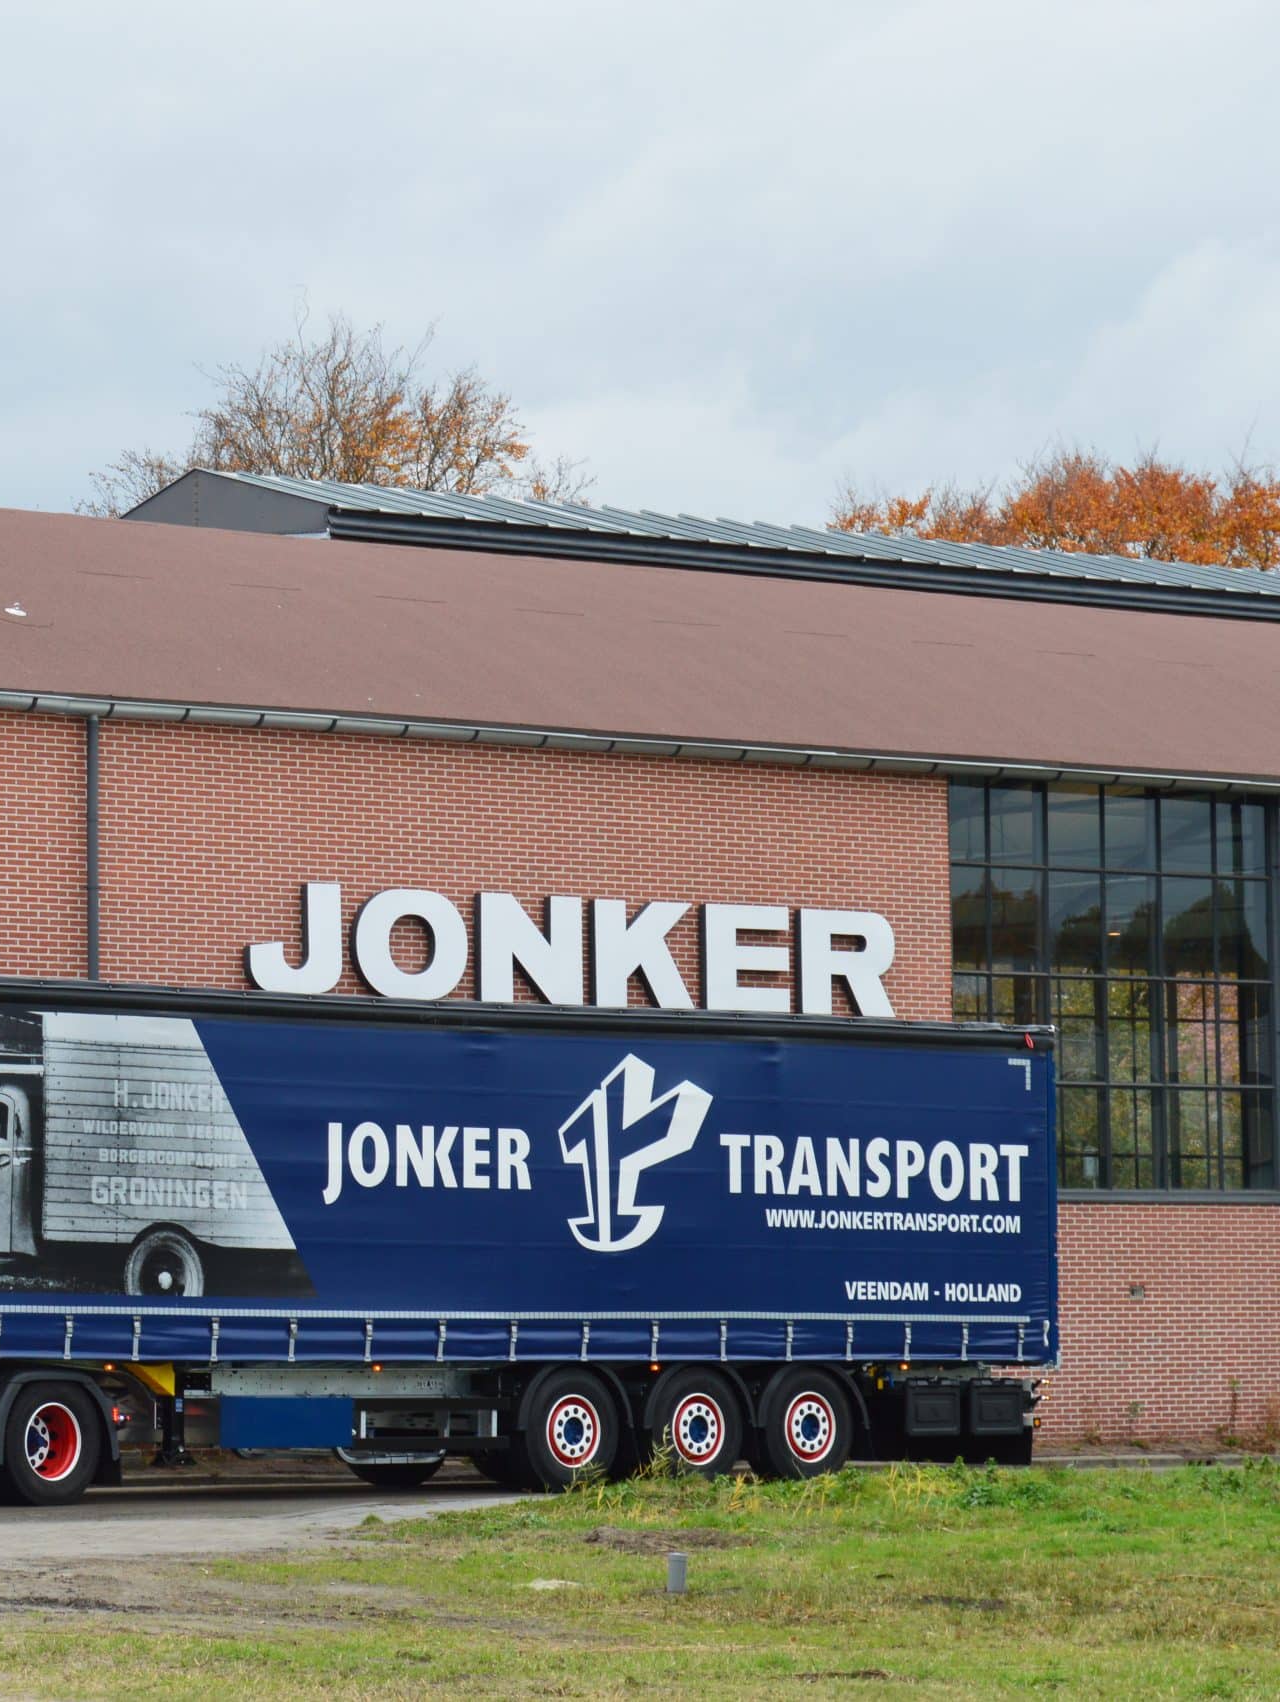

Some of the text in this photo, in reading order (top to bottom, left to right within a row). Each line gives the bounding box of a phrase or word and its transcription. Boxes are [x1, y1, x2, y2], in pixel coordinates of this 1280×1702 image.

[246, 881, 896, 1018] JONKER
[322, 1121, 1029, 1205] JONKER TRANSPORT
[91, 1176, 247, 1209] GRONINGEN
[765, 1208, 1021, 1234] WWW.JONKERTRANSPORT.COM
[844, 1281, 929, 1302] VEENDAM
[944, 1283, 1022, 1303] HOLLAND
